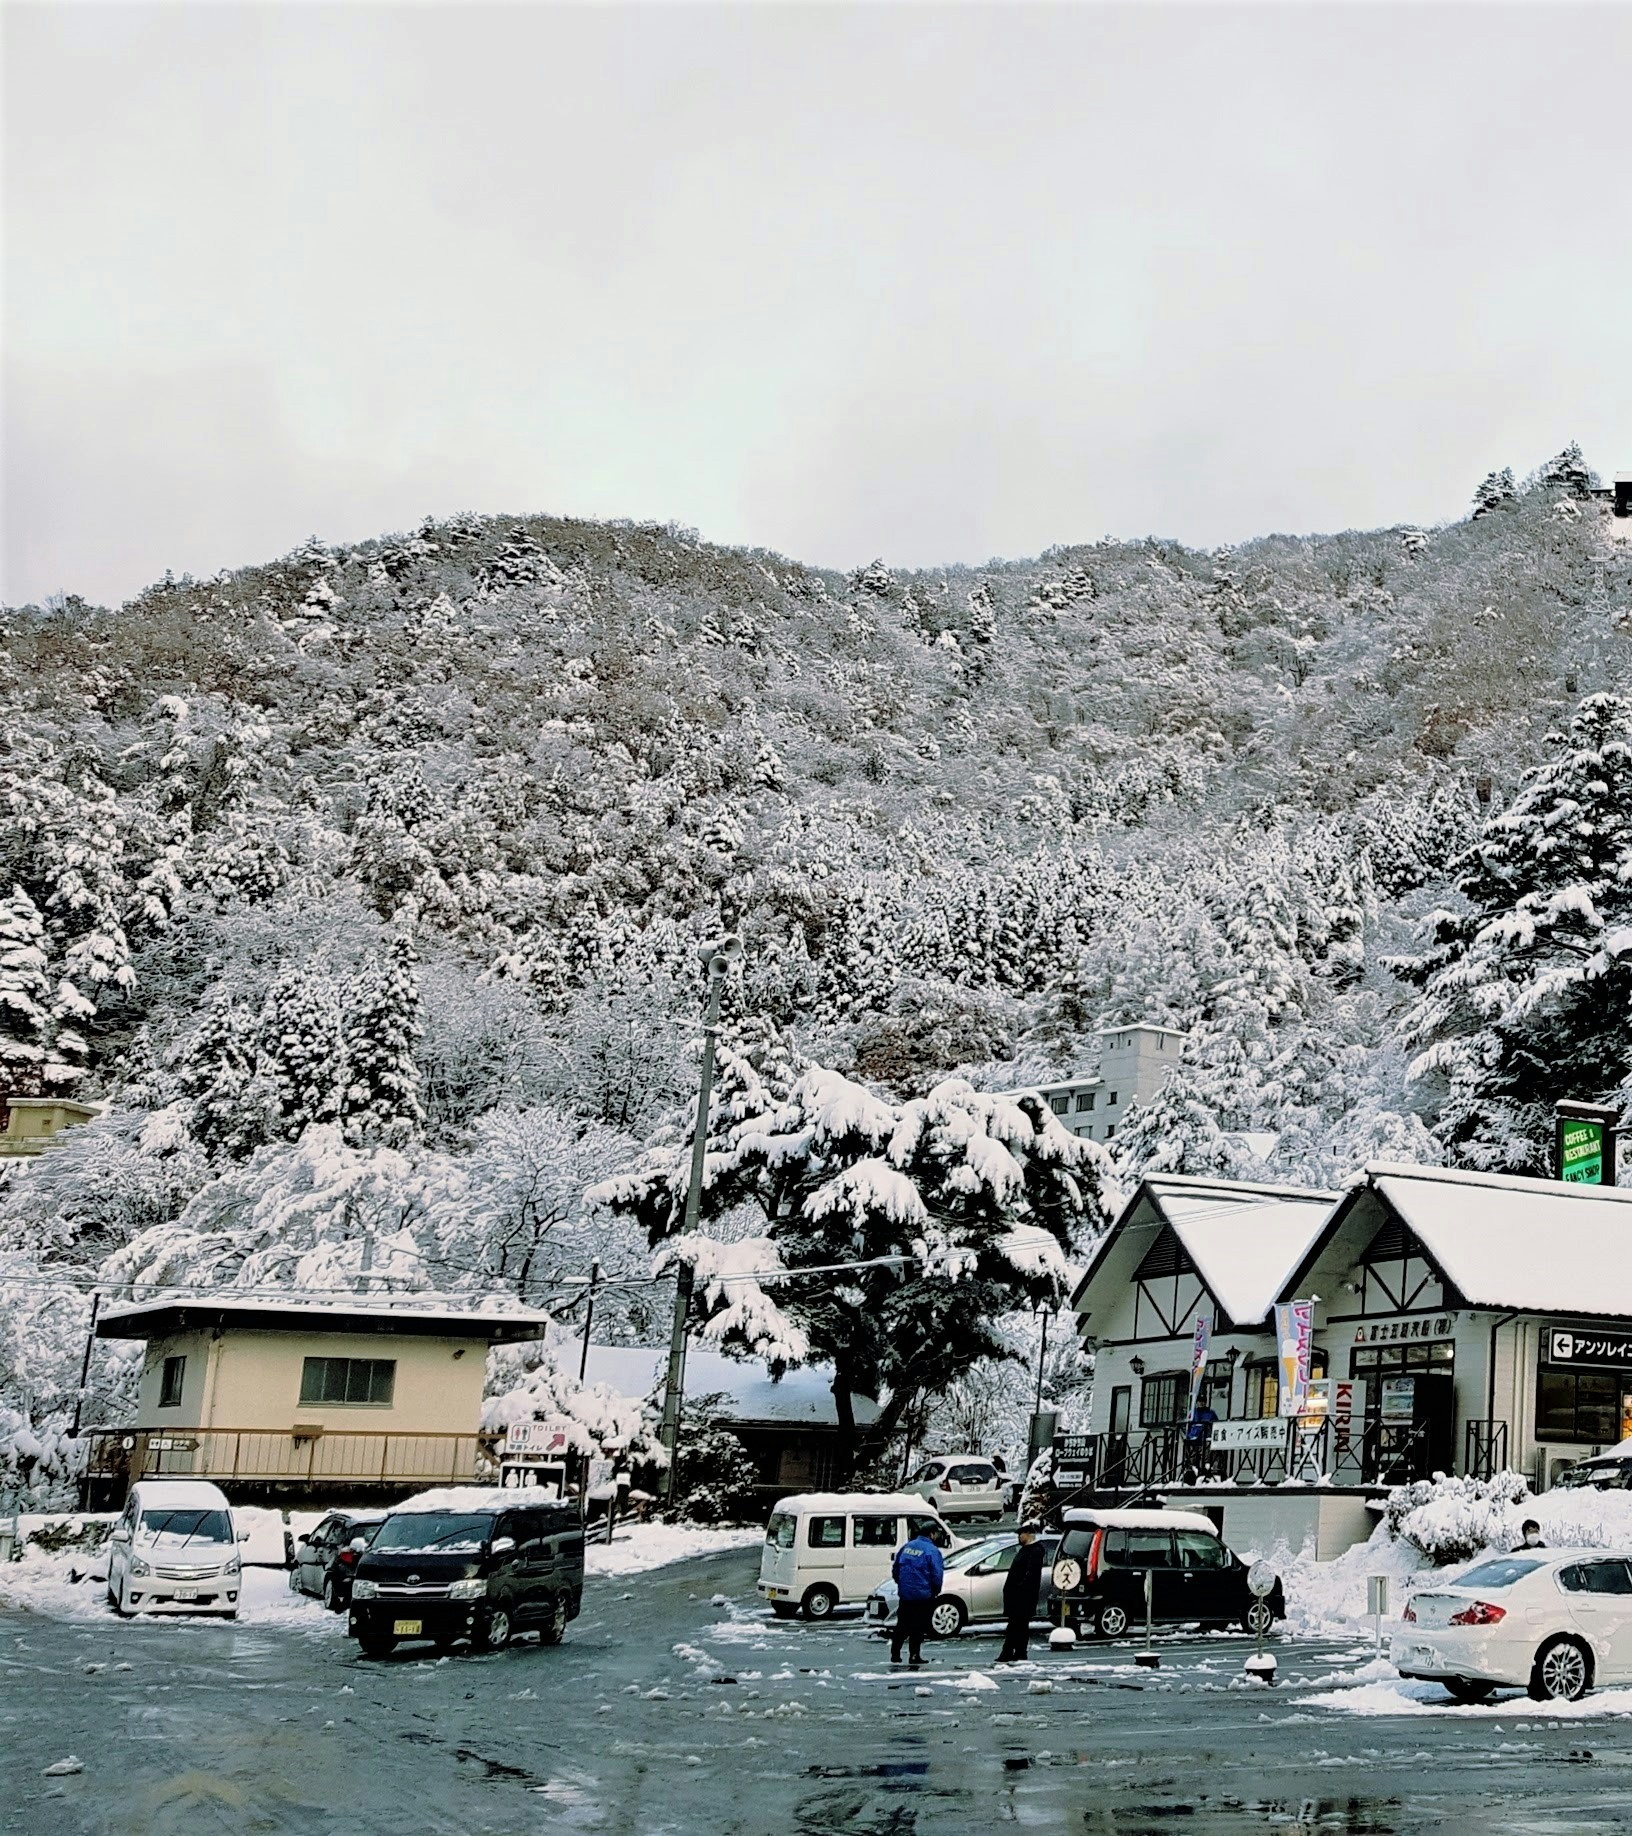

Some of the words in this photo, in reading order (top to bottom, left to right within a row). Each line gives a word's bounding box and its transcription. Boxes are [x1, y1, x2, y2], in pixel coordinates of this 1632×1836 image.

[1565, 1129, 1588, 1146] COFFEE
[1564, 1139, 1601, 1162] RESTAURANT
[1584, 1163, 1600, 1178] SHOP
[533, 1424, 567, 1432] TOILET
[1333, 1383, 1353, 1453] KIRIN
[1060, 1561, 1075, 1585] バス
